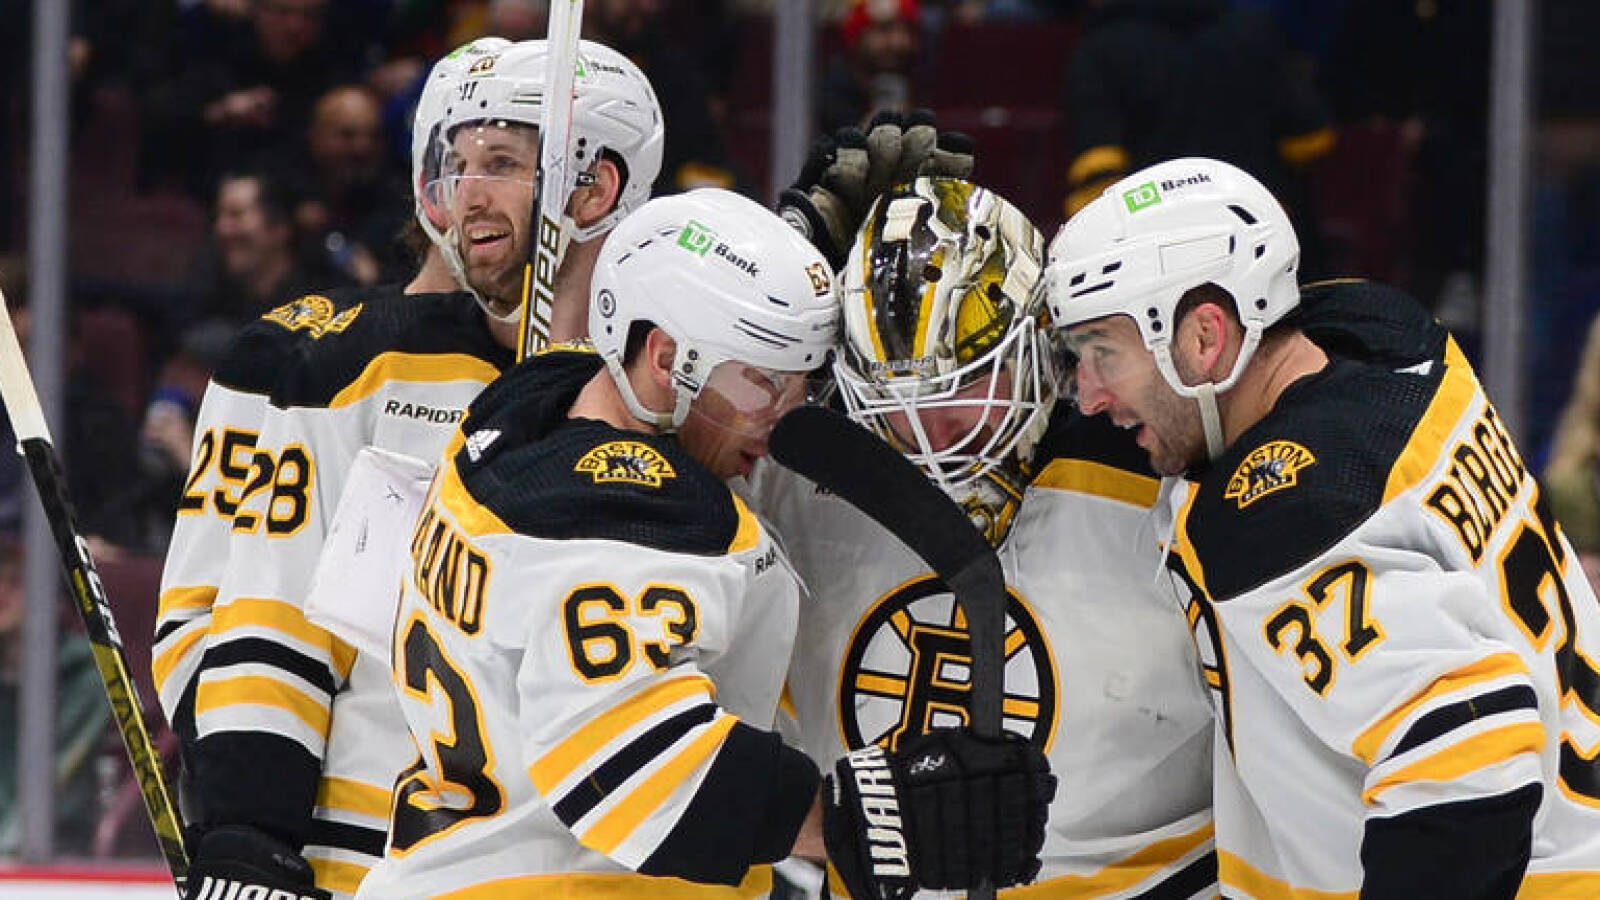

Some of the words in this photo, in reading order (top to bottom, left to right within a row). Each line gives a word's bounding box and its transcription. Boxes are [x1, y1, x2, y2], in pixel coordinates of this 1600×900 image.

[1160, 173, 1212, 191] Bank
[714, 242, 761, 277] Bank
[577, 441, 671, 475] BOSTON
[1226, 443, 1313, 494] BOSTON
[230, 442, 315, 538] 28
[561, 579, 700, 684] 63
[1262, 555, 1386, 698] 37
